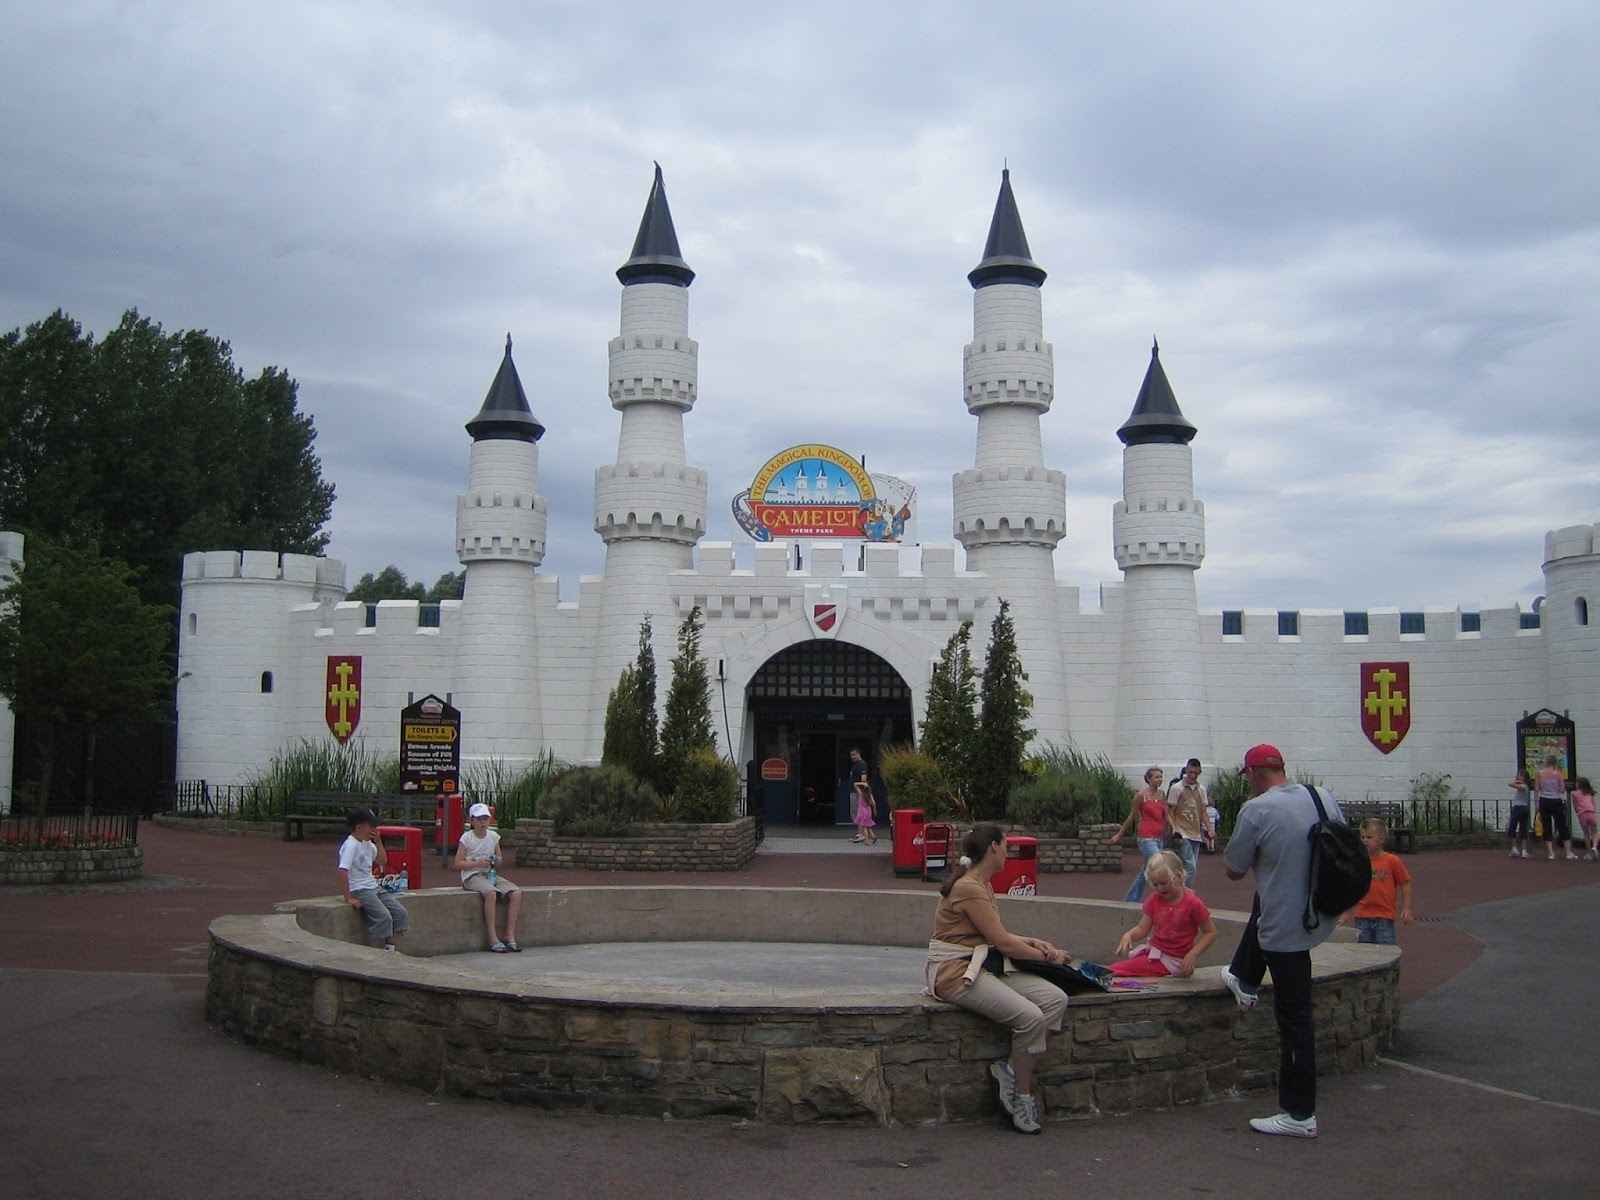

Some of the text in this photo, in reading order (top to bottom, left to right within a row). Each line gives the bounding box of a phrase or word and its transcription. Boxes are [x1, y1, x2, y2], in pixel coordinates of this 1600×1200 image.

[754, 448, 873, 498] THE MAGICAL KINGDOM OF
[762, 509, 860, 528] CAMELOT
